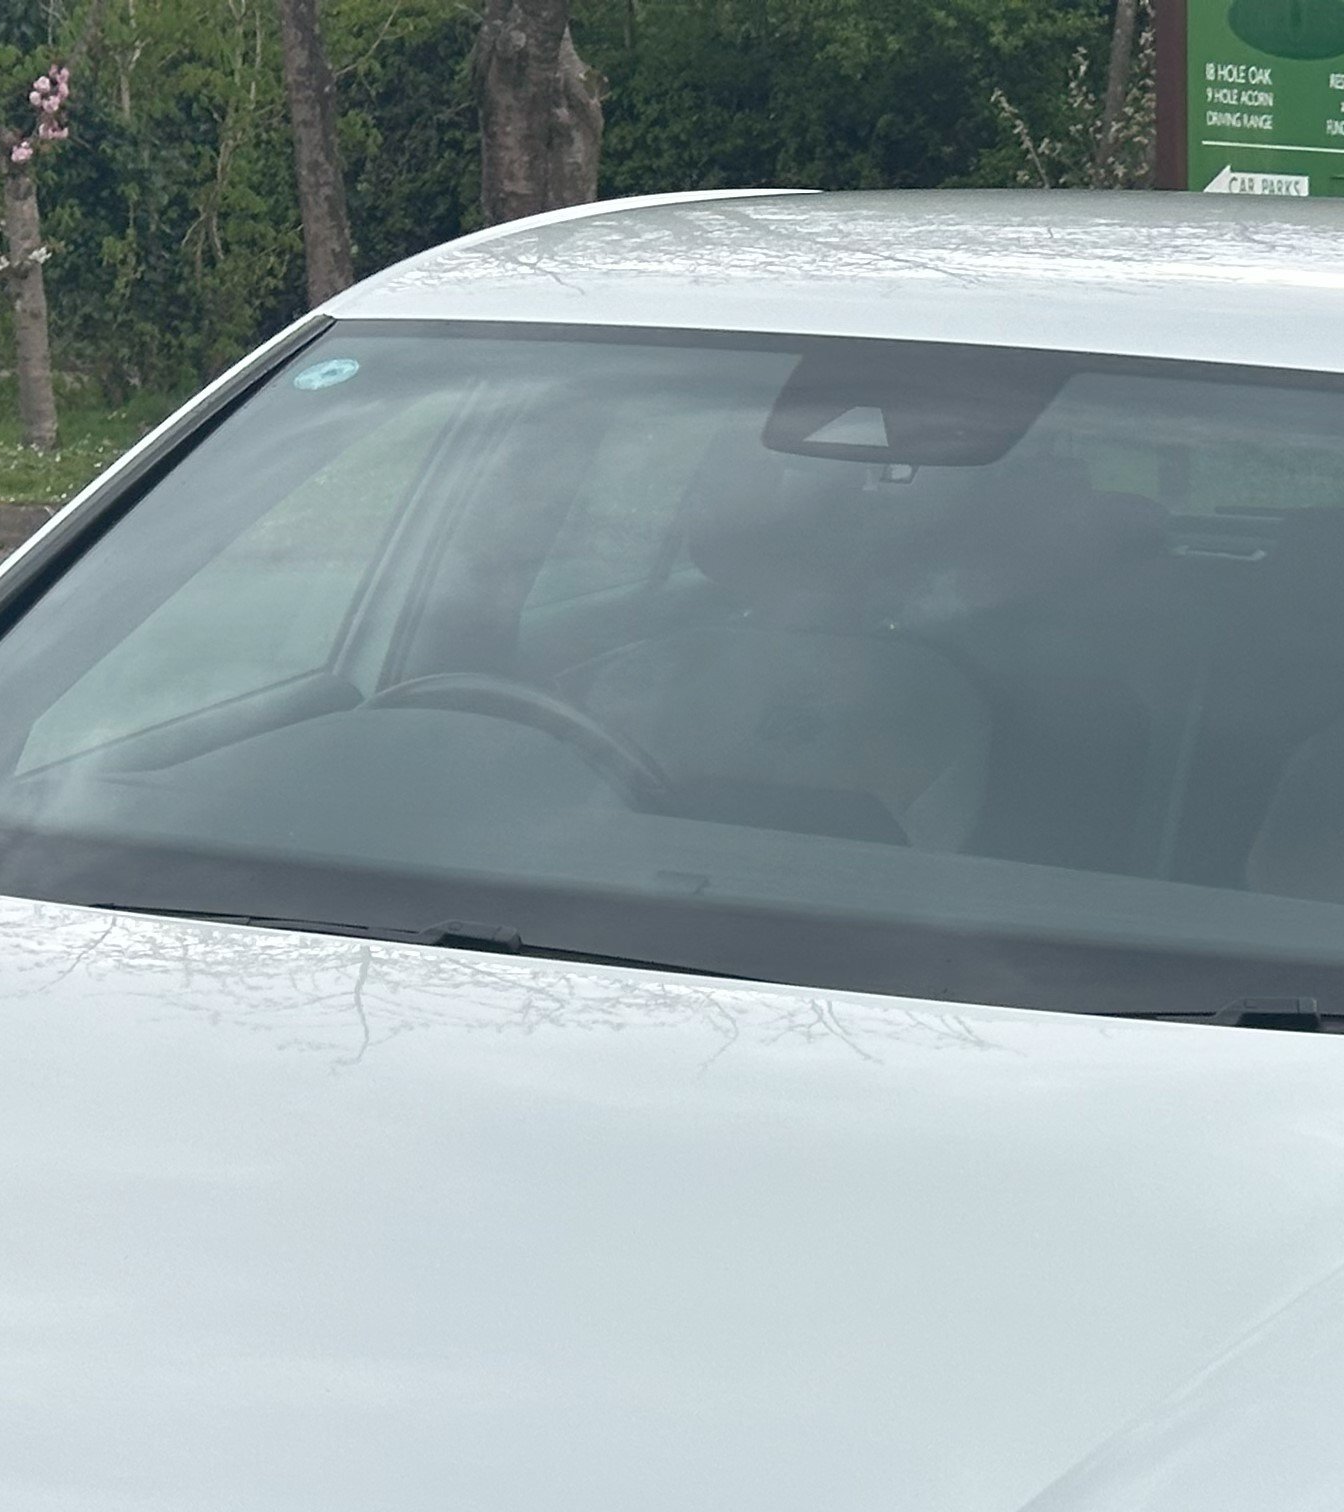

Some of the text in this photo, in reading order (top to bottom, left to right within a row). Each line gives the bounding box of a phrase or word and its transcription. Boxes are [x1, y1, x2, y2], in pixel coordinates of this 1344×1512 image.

[1217, 64, 1246, 83] HOLE
[1248, 66, 1272, 85] OAK
[1206, 87, 1274, 106] 9 HOLE ACORN
[1207, 111, 1273, 129] DRIVING RANGE
[1229, 176, 1301, 195] CAR PARKS
